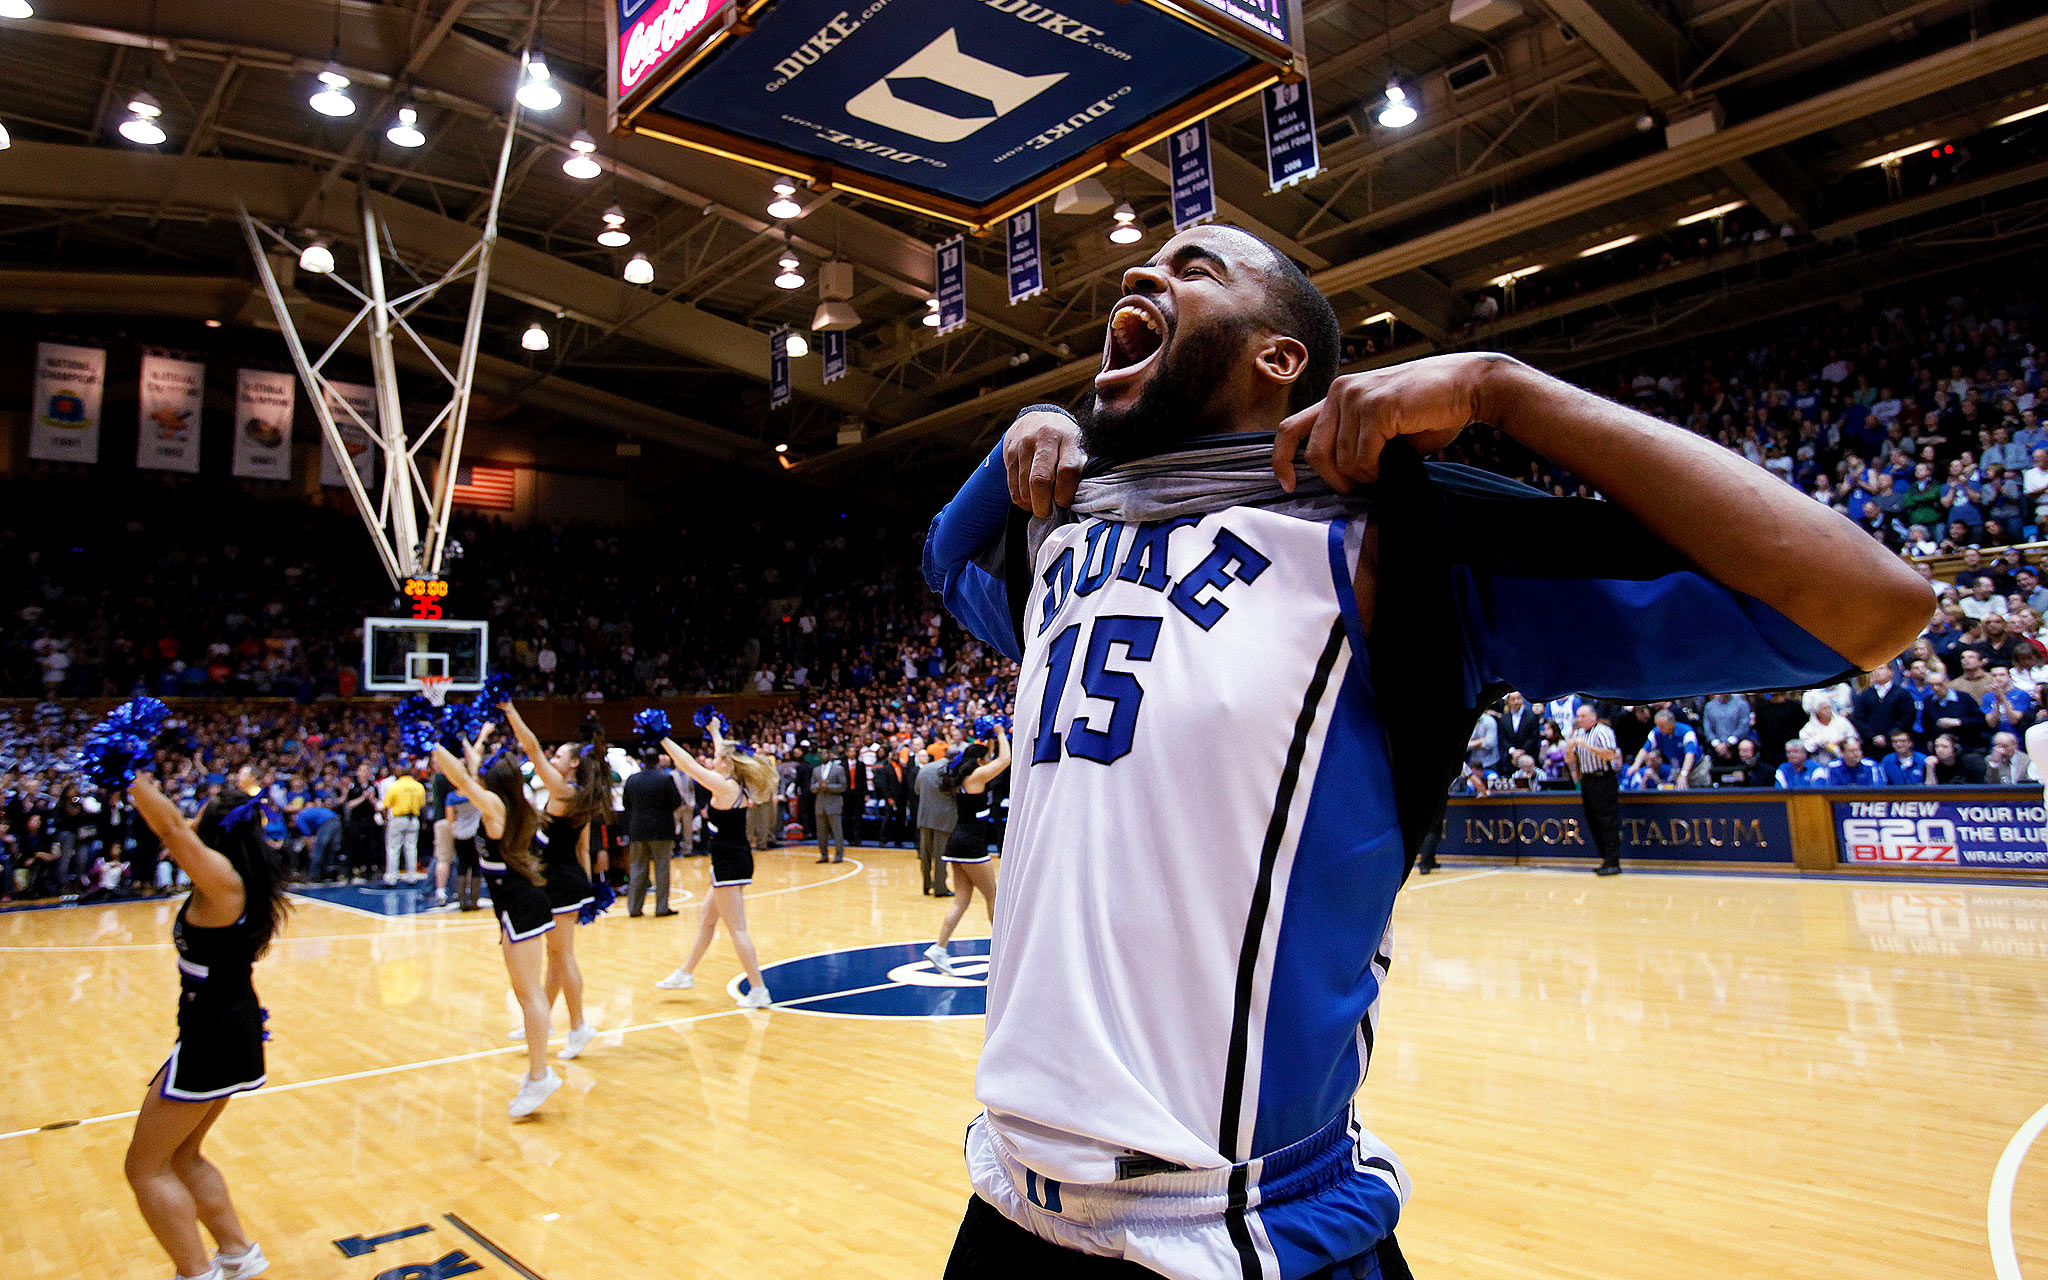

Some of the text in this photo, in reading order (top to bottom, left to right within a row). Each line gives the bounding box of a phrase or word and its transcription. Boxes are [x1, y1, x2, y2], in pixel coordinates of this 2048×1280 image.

[1037, 515, 1272, 632] DUKE
[412, 595, 442, 620] 35
[1031, 614, 1163, 767] 15
[1850, 802, 1939, 817] THE NEW
[1956, 807, 2012, 823] YOUR
[1465, 818, 1585, 845] INDOOR
[1619, 818, 1768, 847] TADIUM
[1843, 819, 1957, 845] 620
[1956, 827, 1996, 842] THE
[1855, 845, 1956, 862] BUZZ
